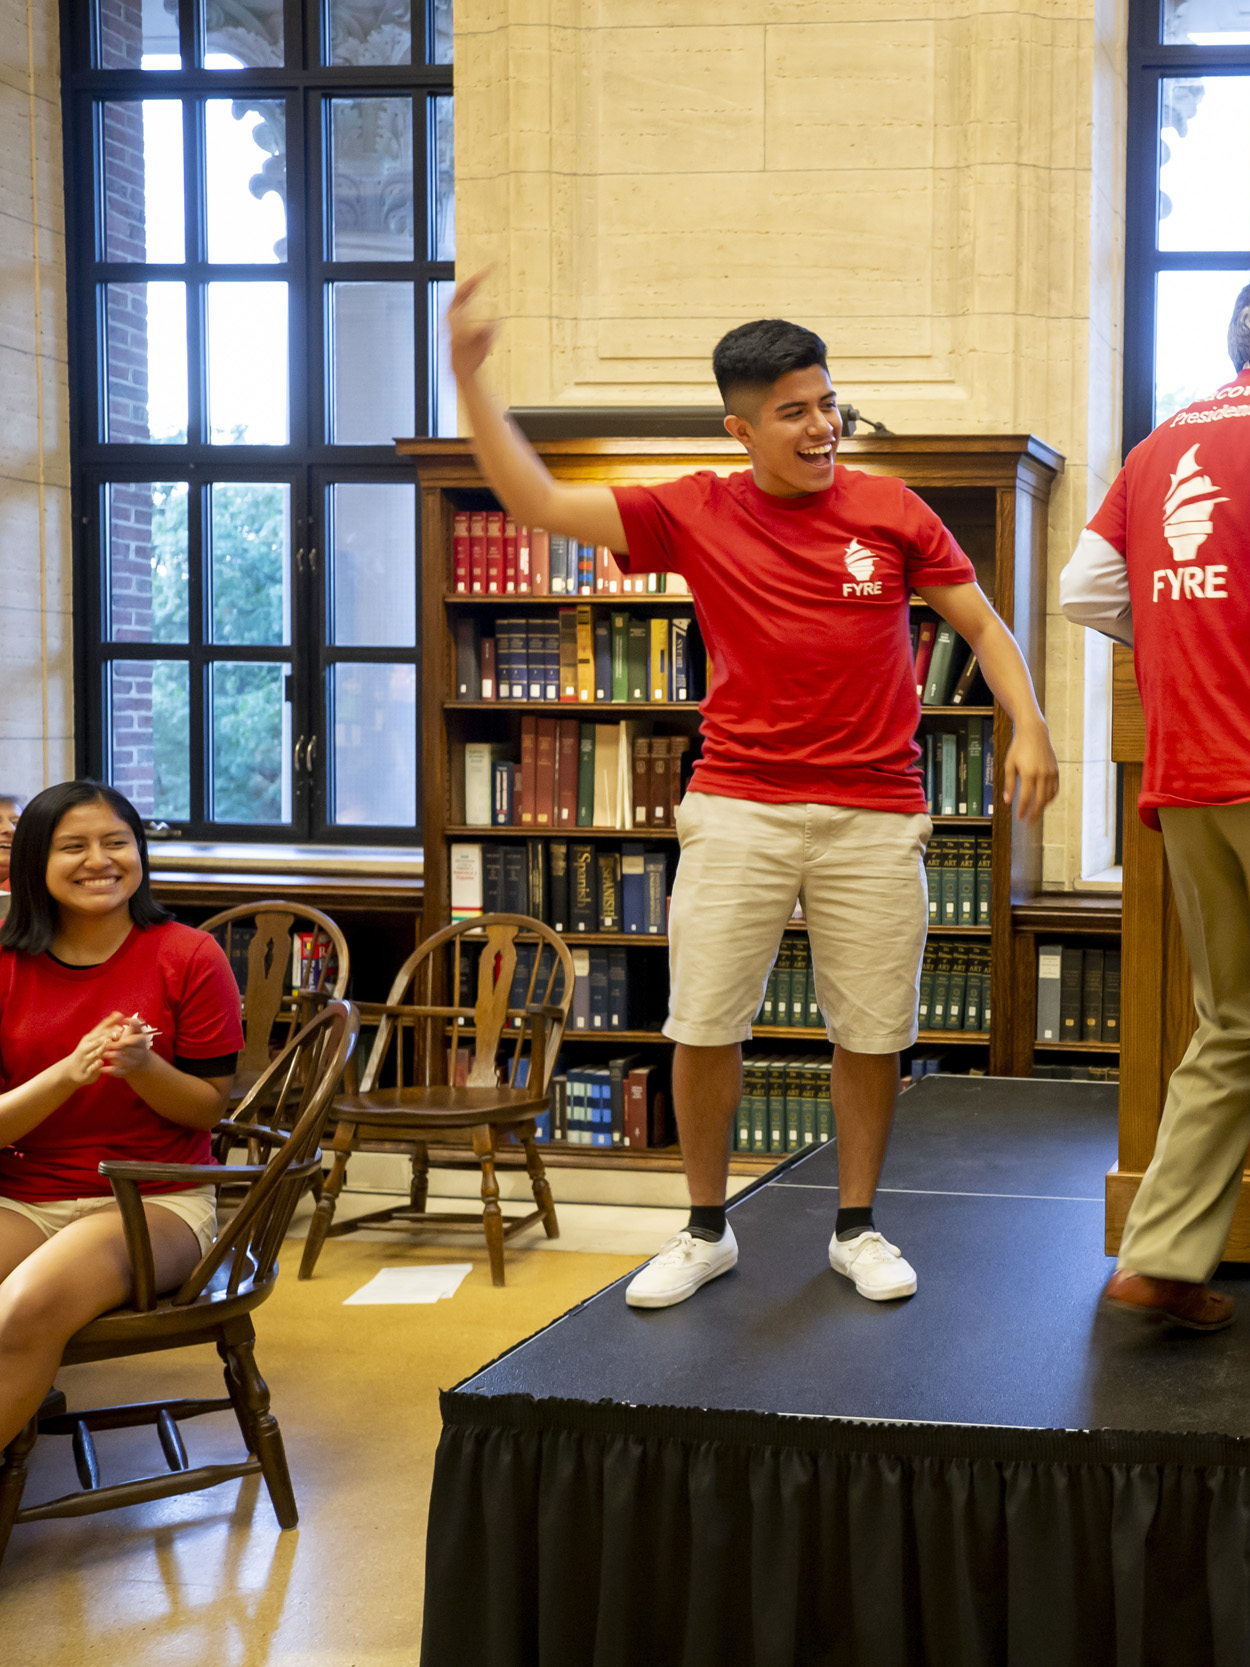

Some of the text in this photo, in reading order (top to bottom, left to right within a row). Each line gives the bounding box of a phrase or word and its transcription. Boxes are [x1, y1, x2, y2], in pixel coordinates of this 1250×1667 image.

[842, 581, 883, 598] FYRE
[1152, 564, 1229, 603] FYRE
[573, 852, 592, 908] Spanish
[602, 866, 615, 917] SPANISH
